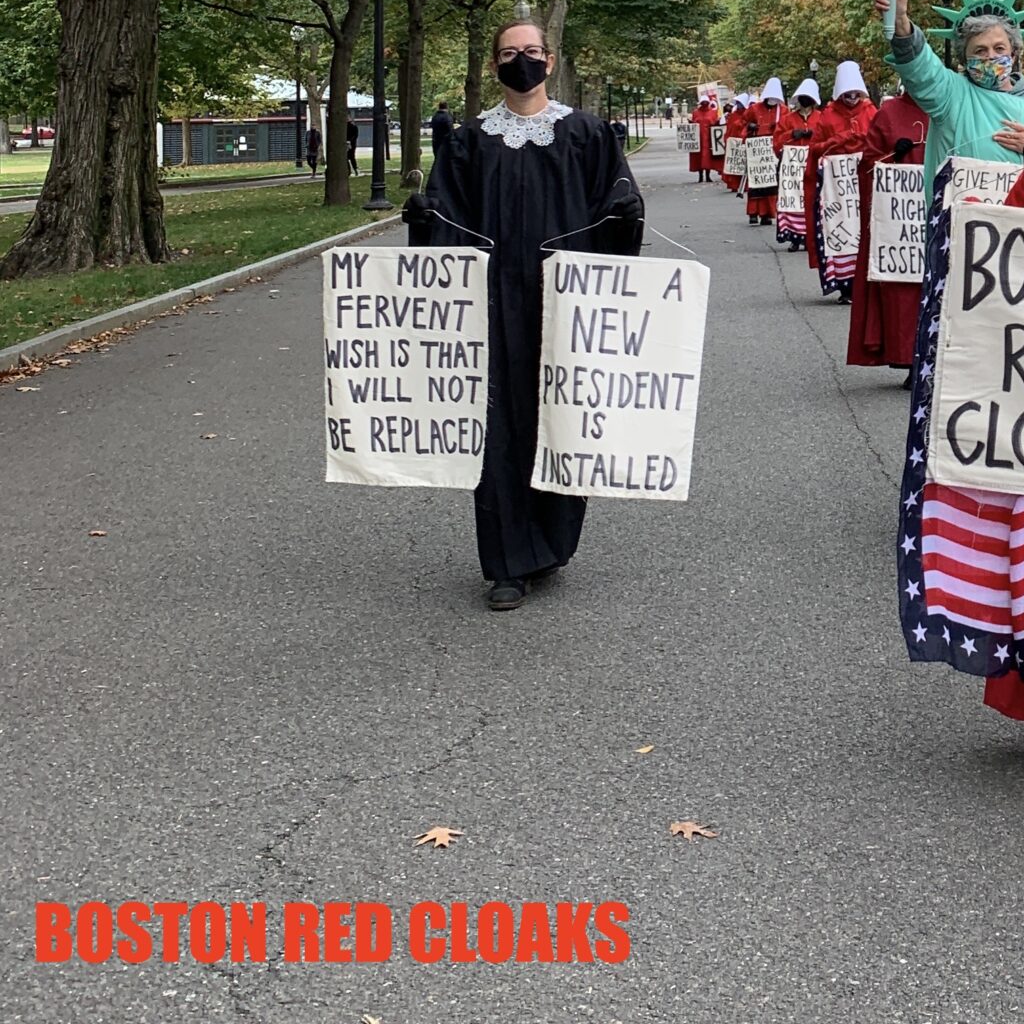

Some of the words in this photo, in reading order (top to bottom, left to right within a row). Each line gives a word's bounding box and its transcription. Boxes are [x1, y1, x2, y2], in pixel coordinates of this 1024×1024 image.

[752, 148, 772, 156] RIGH
[754, 175, 775, 184] RIGH
[876, 167, 924, 193] REPROD
[823, 201, 843, 222] AND
[892, 197, 926, 221] RIGH
[826, 221, 853, 252] GET
[332, 253, 369, 289] MY
[397, 254, 477, 288] MOST
[879, 246, 925, 275] ESSEN
[555, 263, 636, 296] UNTIL
[662, 268, 683, 302] A
[337, 295, 473, 331] FERVENT
[572, 306, 649, 356] NEW
[326, 339, 378, 368] WISH
[391, 339, 409, 367] IS
[420, 341, 484, 368] THAT
[328, 377, 333, 406] I
[349, 377, 412, 403] WILL
[429, 376, 482, 404] NOT
[544, 365, 693, 410] PRESIDENT
[328, 417, 355, 452] BE
[371, 416, 483, 456] REPLACED
[582, 412, 605, 439] IS
[541, 448, 677, 491] INSTALLED
